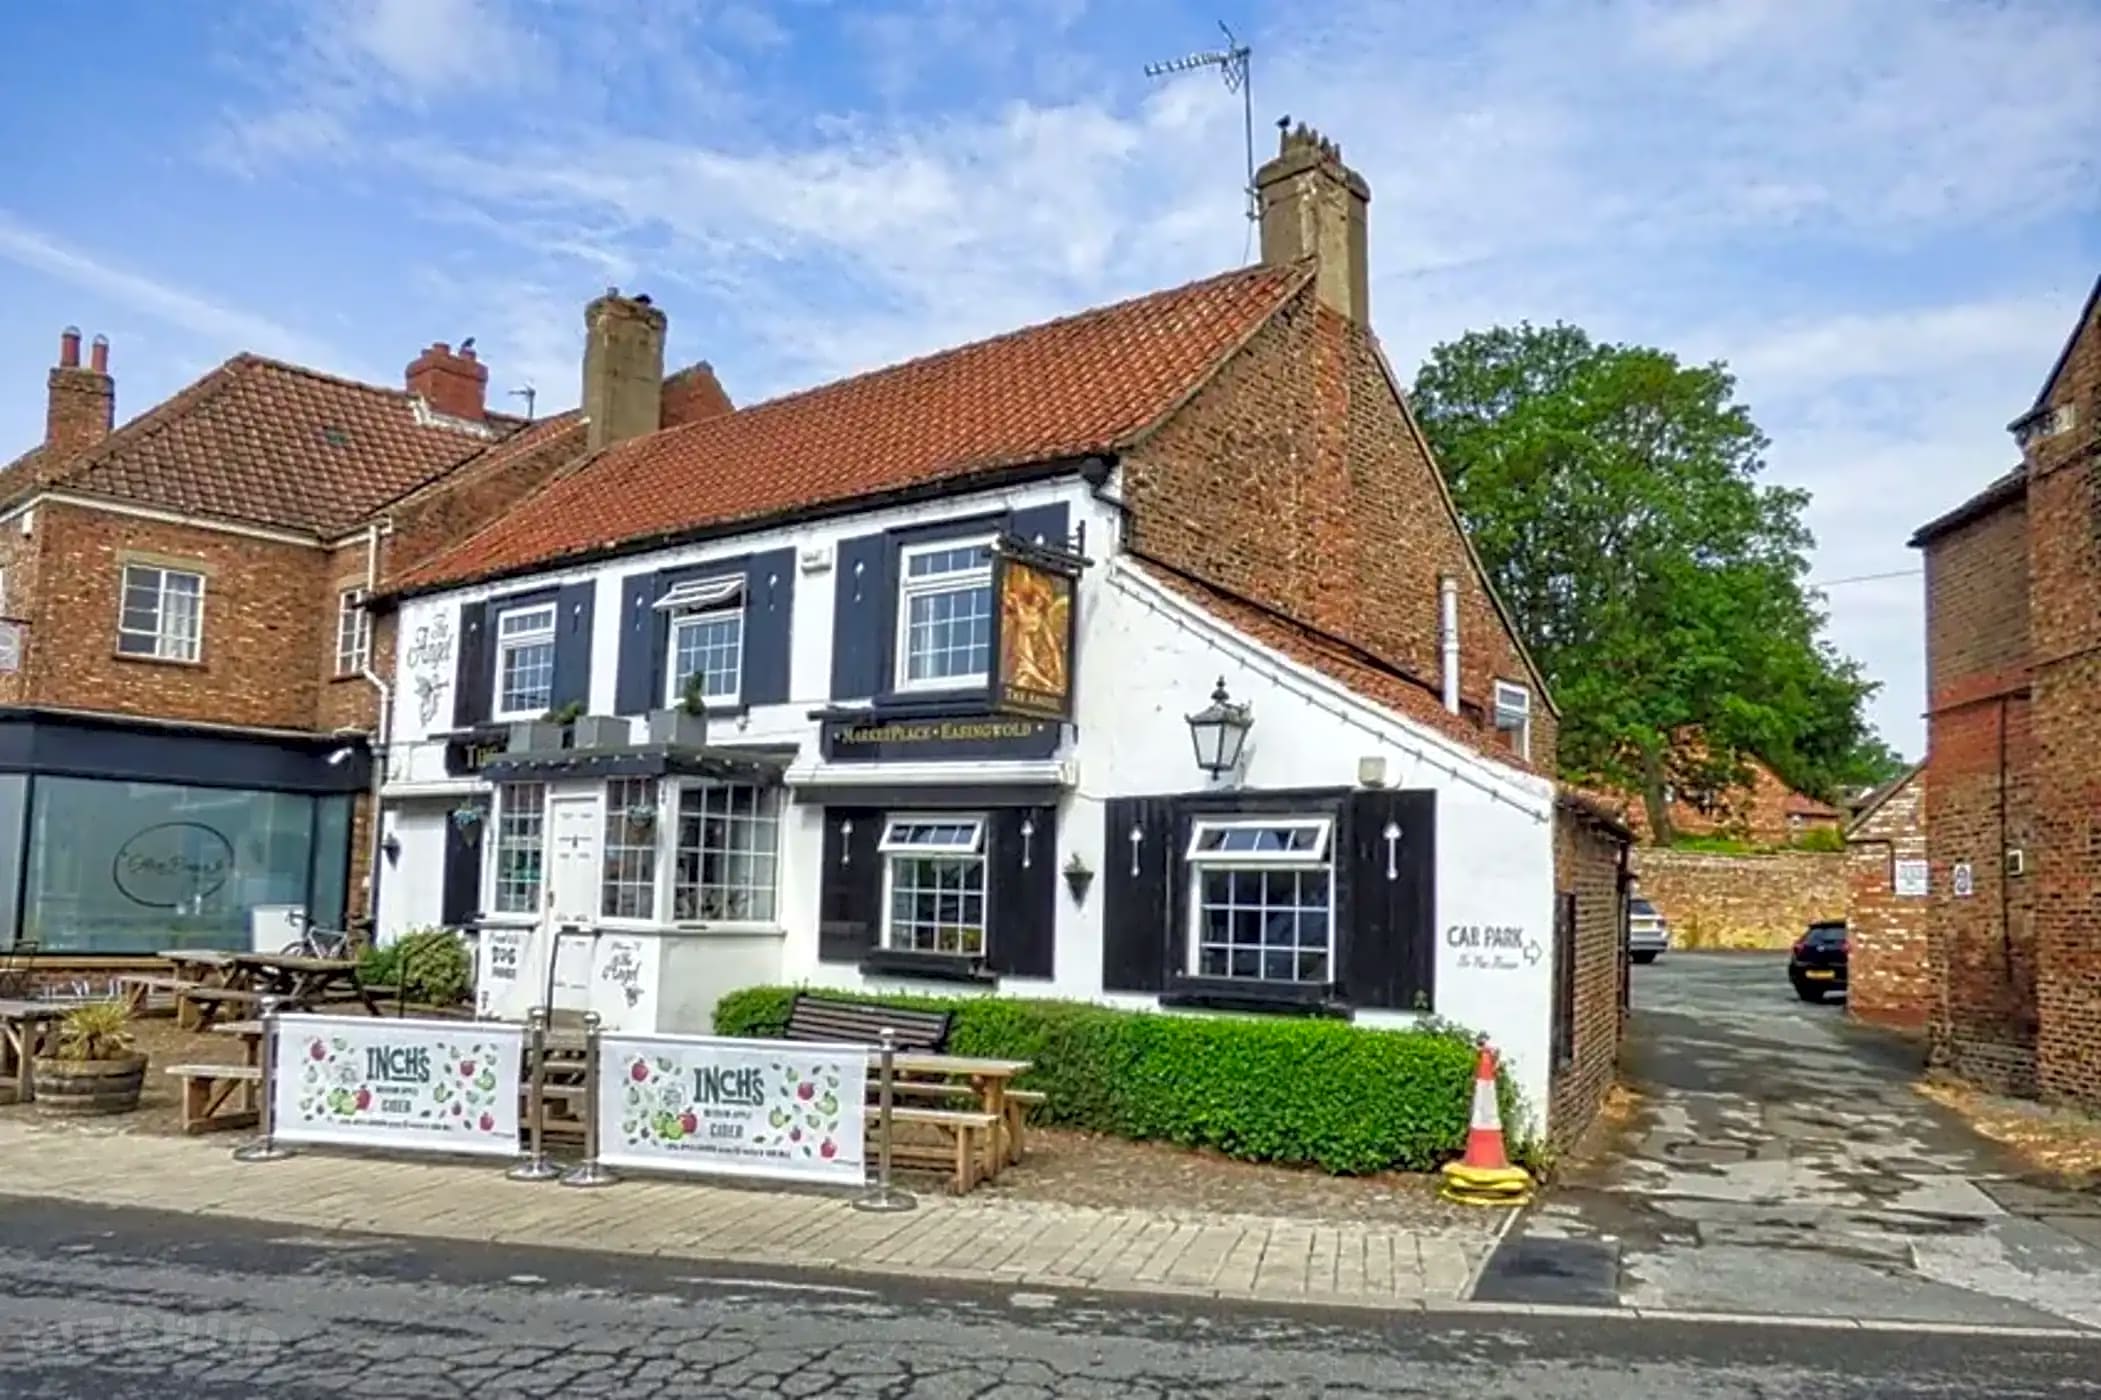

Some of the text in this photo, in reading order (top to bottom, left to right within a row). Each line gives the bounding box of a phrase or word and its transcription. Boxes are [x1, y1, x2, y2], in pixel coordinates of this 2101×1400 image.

[406, 626, 454, 670] Angel
[1446, 925, 1525, 949] CAR PARK
